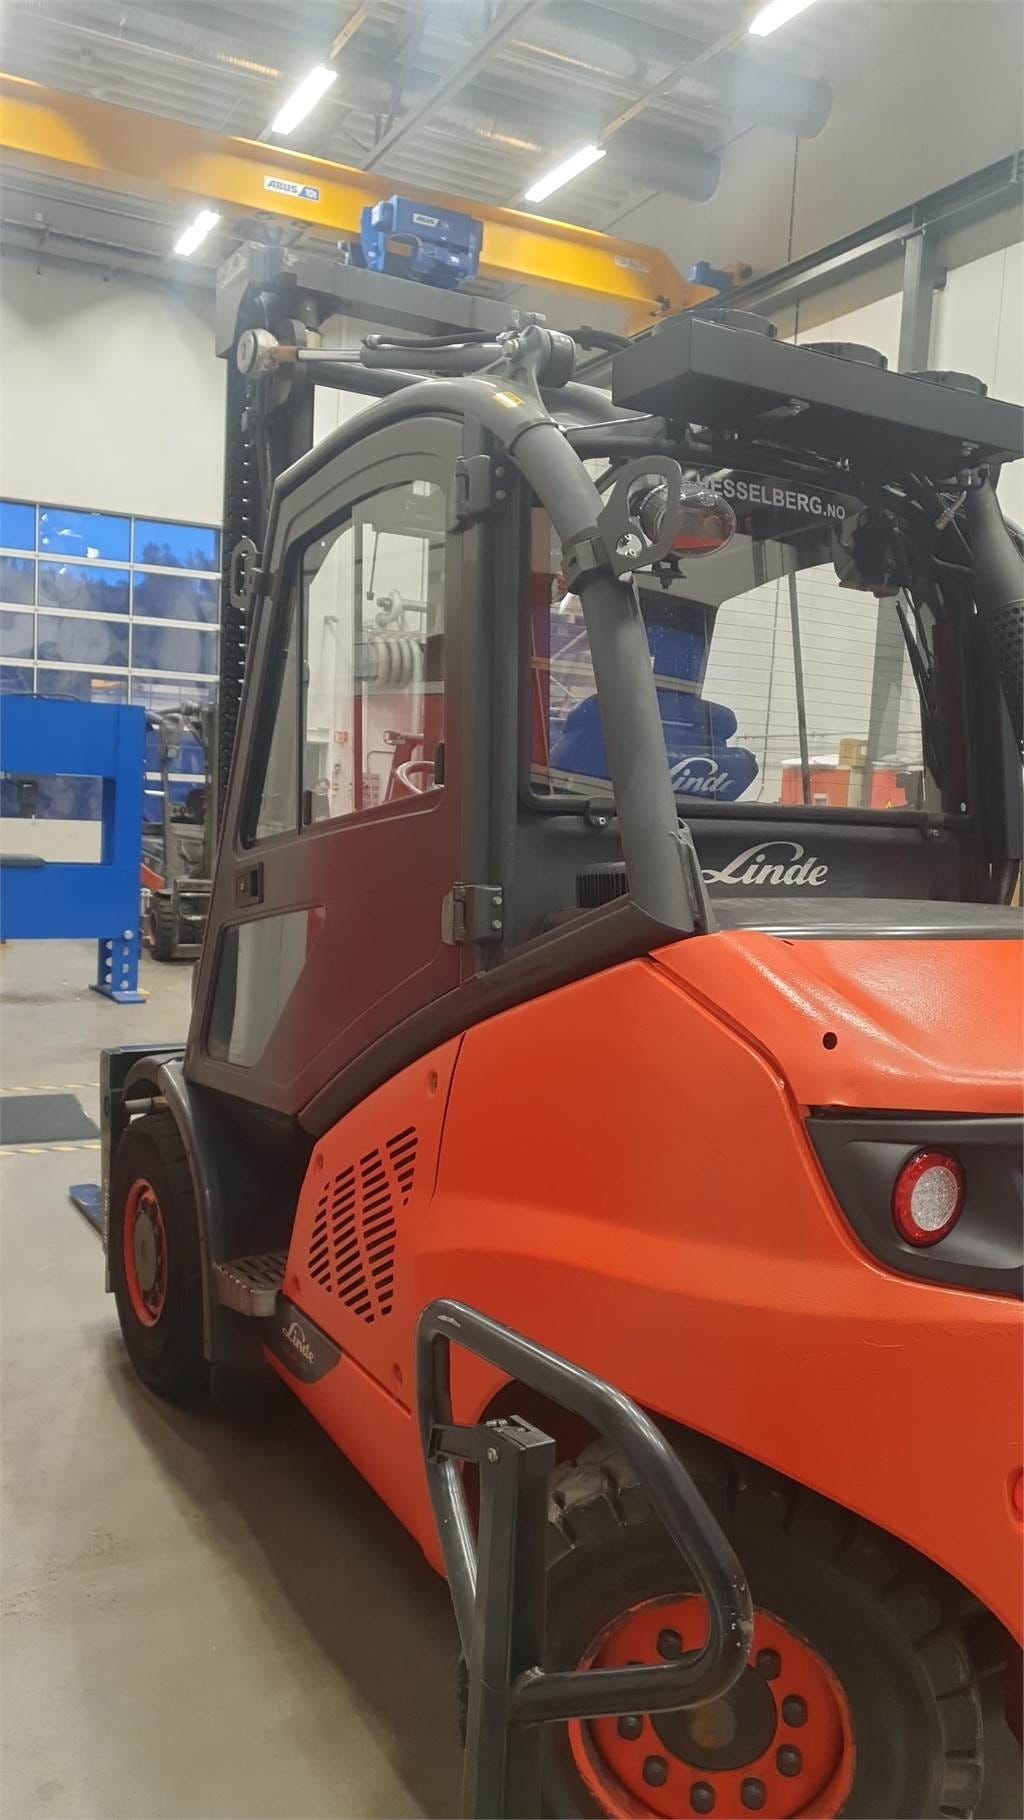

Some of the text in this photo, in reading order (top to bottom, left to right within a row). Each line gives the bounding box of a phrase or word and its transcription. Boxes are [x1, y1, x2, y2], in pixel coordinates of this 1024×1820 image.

[268, 180, 298, 193] ABUS
[701, 841, 829, 886] Linde
[281, 1322, 314, 1364] Linde
